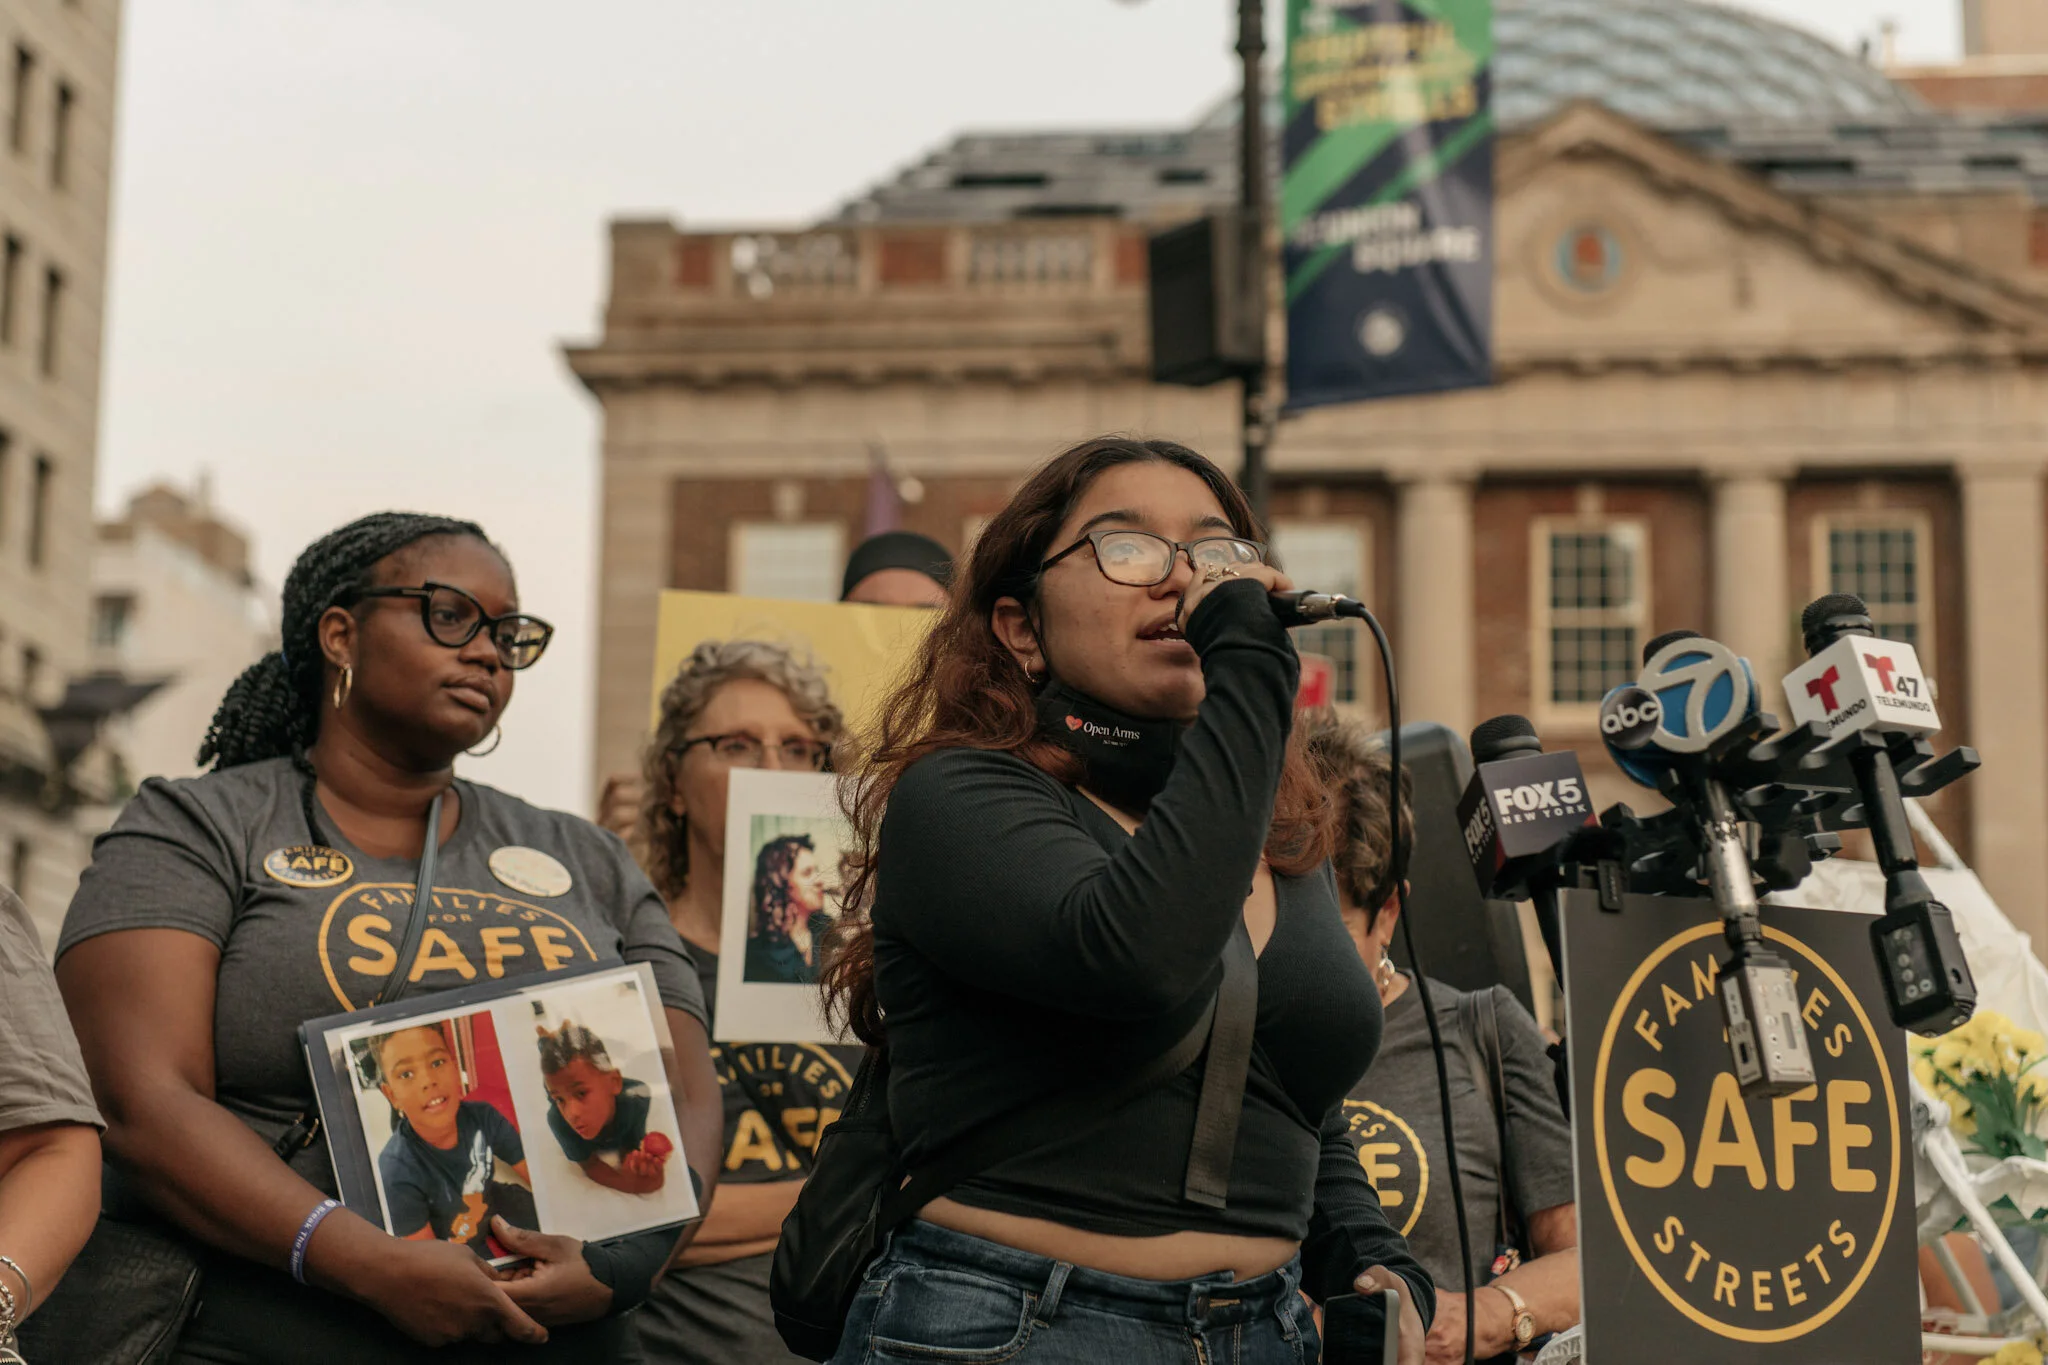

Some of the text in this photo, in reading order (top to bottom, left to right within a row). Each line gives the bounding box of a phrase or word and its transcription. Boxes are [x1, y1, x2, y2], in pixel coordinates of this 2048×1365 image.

[1896, 676, 1918, 698] 47
[1875, 695, 1931, 712] TELEMUNDO
[1083, 721, 1140, 740] Open Arms
[1601, 701, 1659, 734] abc
[1493, 777, 1582, 815] FOX 5
[1501, 804, 1587, 825] NEW YORK
[428, 913, 473, 924] FOR
[347, 913, 574, 983] SAFE
[1622, 1067, 1878, 1193] SAFE
[1653, 1215, 1856, 1312] STREETS
